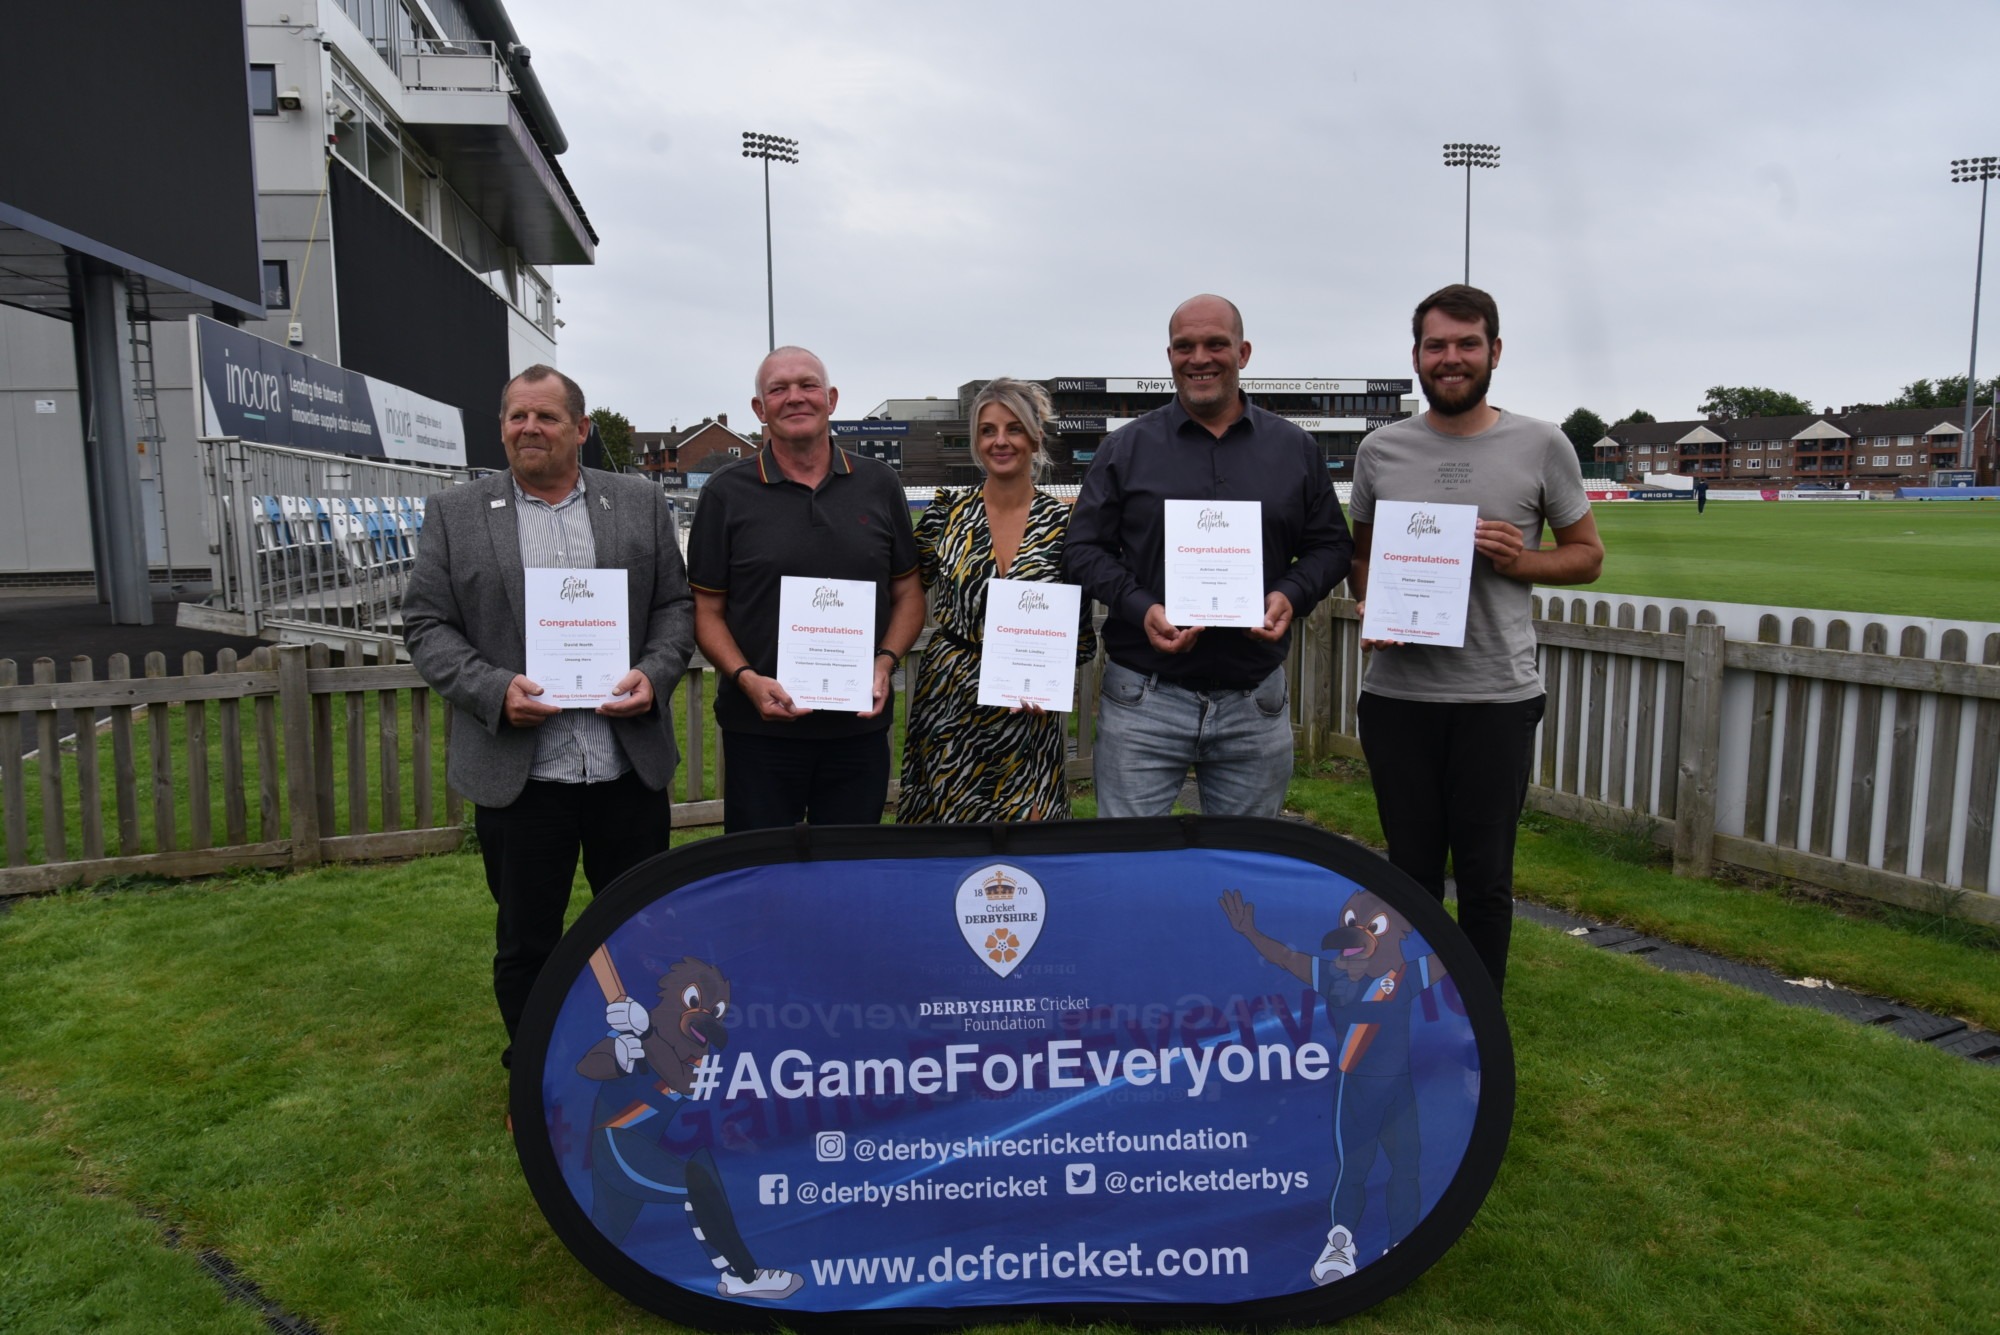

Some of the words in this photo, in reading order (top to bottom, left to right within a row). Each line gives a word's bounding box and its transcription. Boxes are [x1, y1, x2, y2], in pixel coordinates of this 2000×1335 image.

[226, 349, 280, 412] incora
[1058, 381, 1081, 390] RWM
[1138, 381, 1166, 392] Ryley
[1240, 381, 1300, 390] erformance
[1305, 382, 1339, 390] Centre
[1368, 382, 1388, 391] RWM
[290, 374, 313, 401] Leading
[314, 382, 322, 399] the
[323, 384, 337, 403] future
[338, 390, 343, 404] of
[291, 404, 320, 426] innovative
[321, 413, 338, 433] supply
[338, 414, 351, 431] chain
[352, 418, 371, 435] solutions
[385, 398, 412, 437] incora
[1059, 420, 1081, 429] RWM
[1178, 546, 1251, 554] Congratulations
[1383, 552, 1460, 565] Congratulations
[539, 619, 616, 628] Congratulations
[792, 624, 863, 635] Congratulations
[997, 626, 1066, 637] Congratulations
[974, 889, 983, 897] 18
[986, 904, 1015, 912] Cricket
[965, 913, 1037, 924] DERBYSHIRE
[920, 1000, 1036, 1016] DERBYSHIRE
[1040, 996, 1090, 1011] Cricket
[964, 1017, 1045, 1031] Foundation
[690, 1039, 1330, 1101] #AGameForEveryone
[854, 1128, 1248, 1164] @derbyshirecricketfoundation
[1105, 1167, 1309, 1194] @cricketderbys
[797, 1174, 1048, 1207] @derbyshirecricket
[811, 1241, 1249, 1286] www.dcfcricket.com
